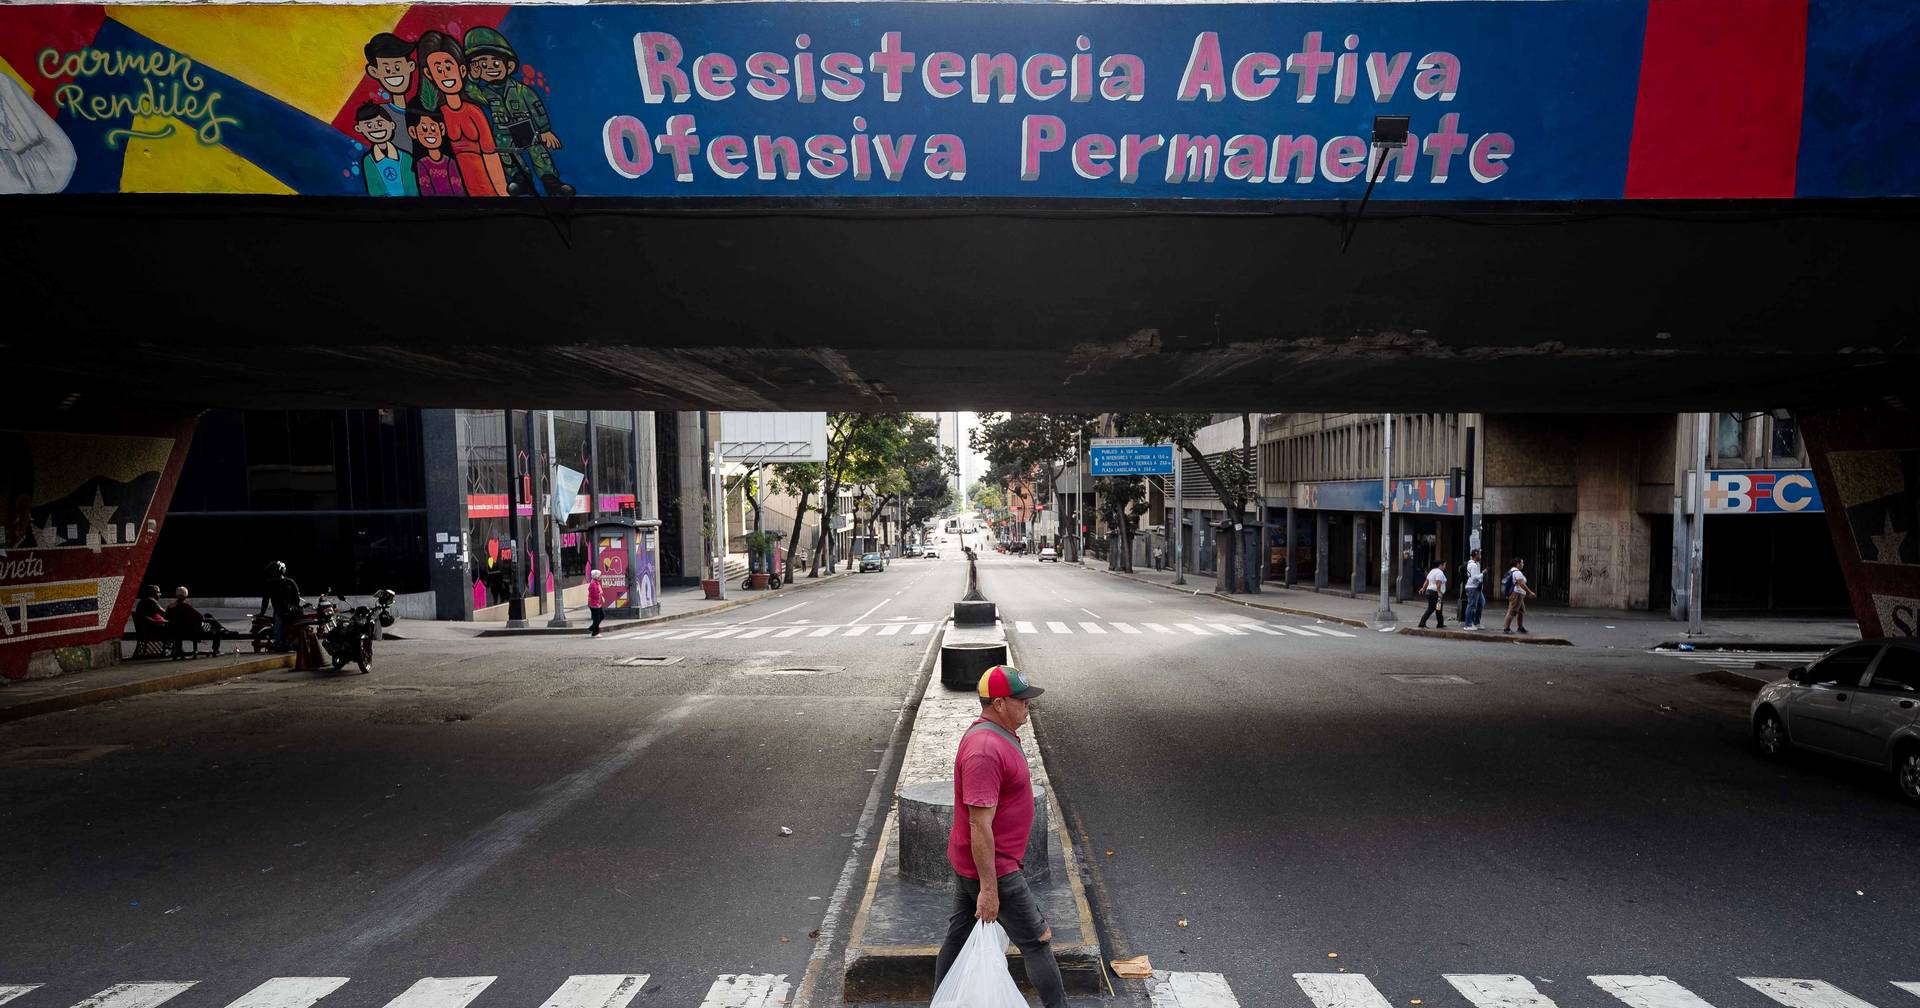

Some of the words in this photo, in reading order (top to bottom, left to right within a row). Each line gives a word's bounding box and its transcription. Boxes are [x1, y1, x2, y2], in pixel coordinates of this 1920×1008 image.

[632, 31, 1146, 104] Resistencia
[1176, 31, 1461, 104] Activa
[55, 77, 239, 145] Rendiles
[602, 113, 967, 183] Ofensiva
[1020, 112, 1516, 184] Permanente
[1718, 473, 1813, 512] BFC
